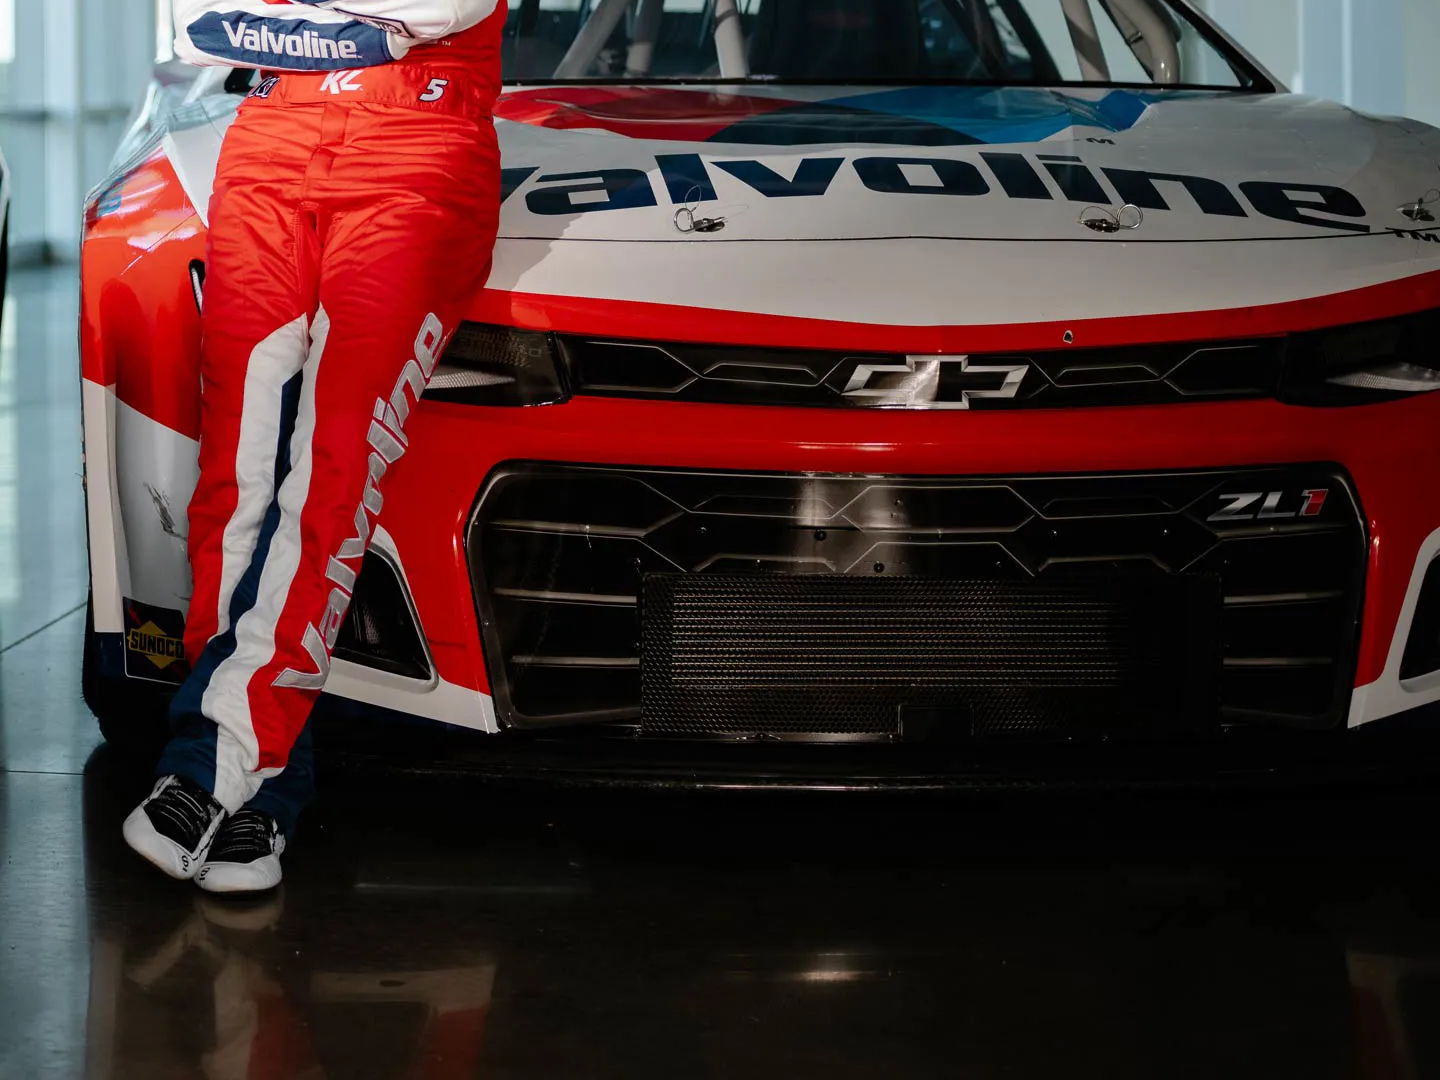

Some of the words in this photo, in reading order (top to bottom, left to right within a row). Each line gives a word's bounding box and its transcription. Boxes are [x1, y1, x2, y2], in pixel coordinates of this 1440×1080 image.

[222, 20, 358, 60] Valvoline
[418, 77, 449, 103] 5
[271, 311, 444, 690] Valvoline
[1206, 488, 1330, 522] ZL1
[130, 629, 185, 660] SUNOCO
